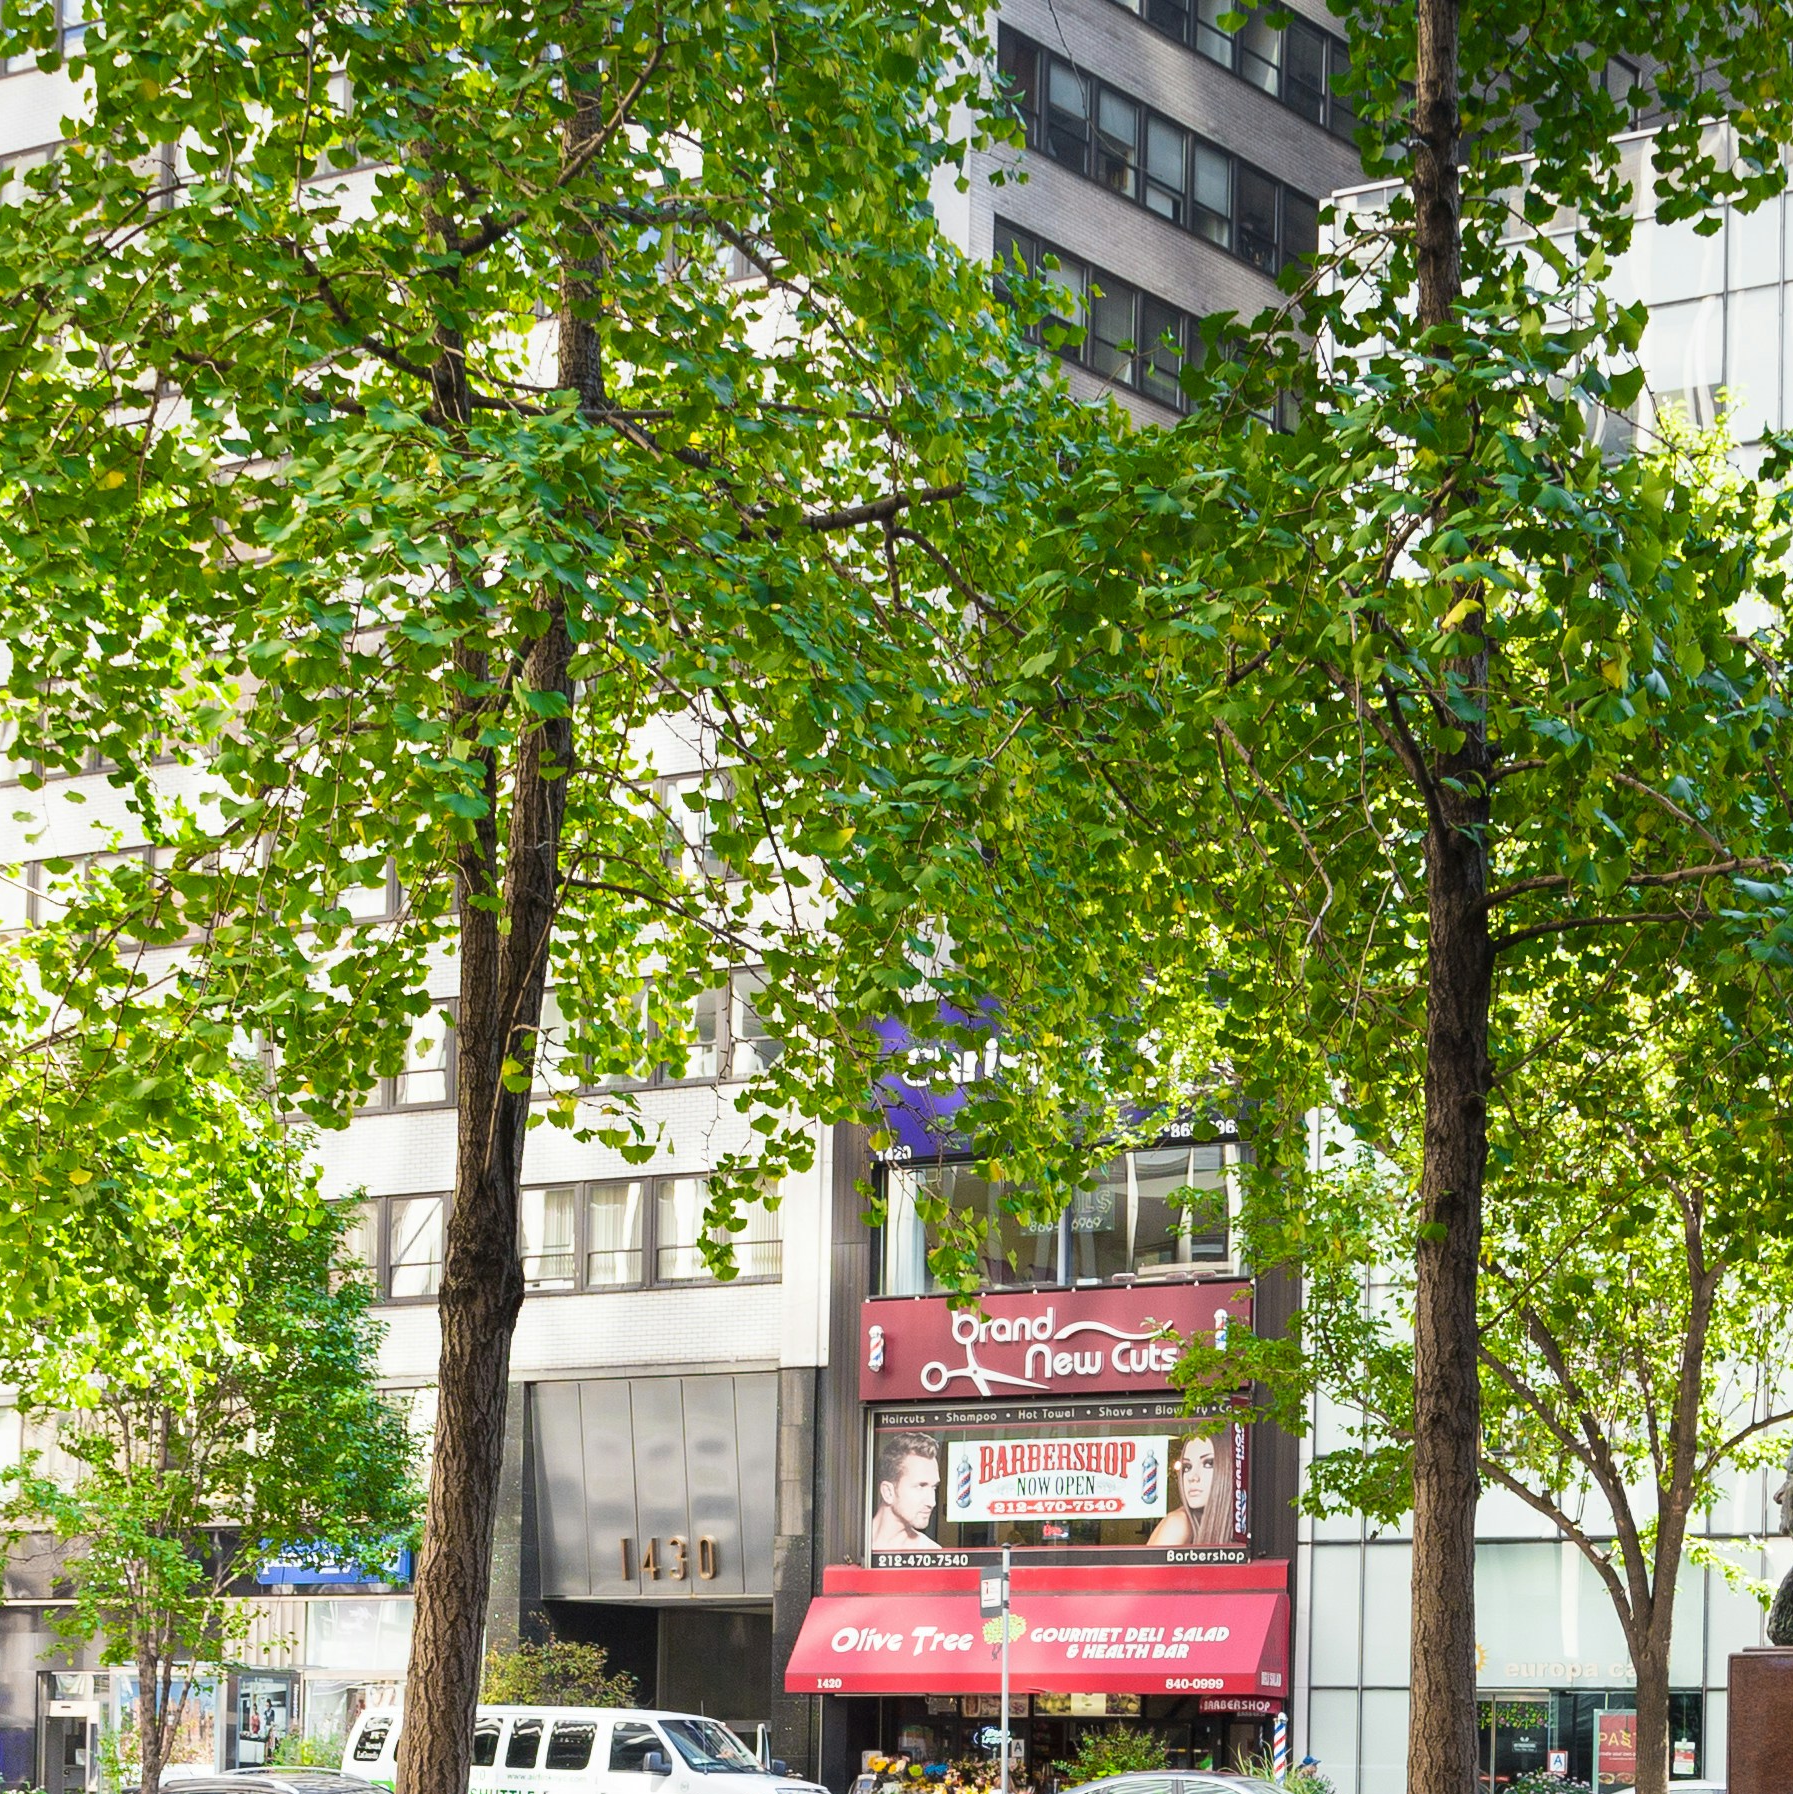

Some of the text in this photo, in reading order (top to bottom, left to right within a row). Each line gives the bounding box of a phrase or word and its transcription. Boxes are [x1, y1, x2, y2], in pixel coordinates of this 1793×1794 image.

[1025, 1341, 1179, 1379] New Cuts
[881, 1414, 926, 1425] Haircuts
[946, 1412, 998, 1424] Shampoo
[1018, 1410, 1038, 1420] Hot
[1042, 1408, 1075, 1419] Towel
[1098, 1405, 1134, 1417] Shave
[979, 1441, 1136, 1484] BARBERSHOP
[1017, 1475, 1096, 1497] NOW OPEN
[993, 1499, 1119, 1514] 212-470-7540
[620, 1536, 716, 1580] 1430
[878, 1554, 969, 1567] 212-470-7540
[1166, 1550, 1245, 1564] Barbershop
[831, 1626, 975, 1657] Olive Tree
[1030, 1626, 1230, 1643] GOURMET DELI SALAD
[1066, 1643, 1191, 1660] & HEALTH BAR
[1504, 1660, 1599, 1682] europa
[816, 1678, 843, 1689] 1420
[1165, 1678, 1224, 1690] 840-0999
[1204, 1700, 1271, 1711] BARBERSHOP
[1013, 1741, 1023, 1752] A
[1599, 1730, 1636, 1748] PAS
[1553, 1754, 1563, 1767] A
